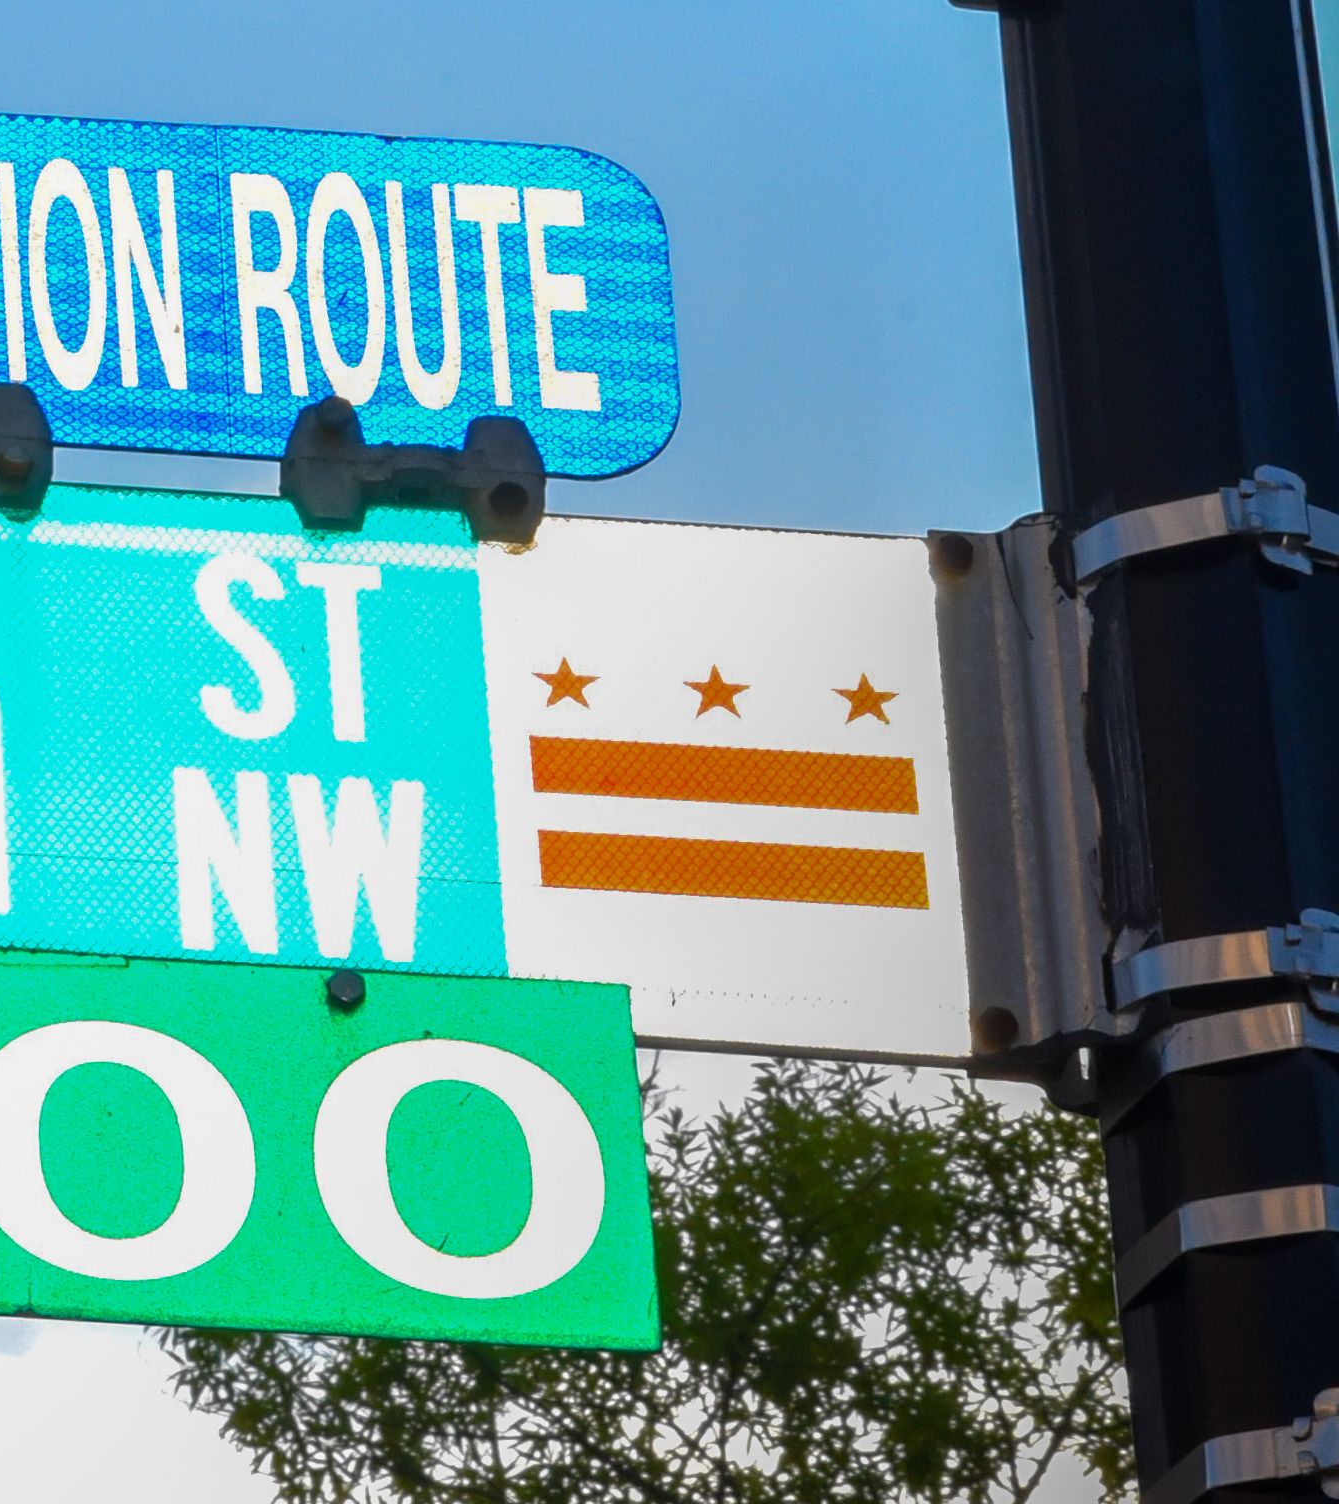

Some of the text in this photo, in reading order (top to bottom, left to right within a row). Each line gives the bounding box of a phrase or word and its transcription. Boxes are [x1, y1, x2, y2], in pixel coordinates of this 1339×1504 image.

[230, 173, 601, 411] ROUTE
[194, 552, 381, 742] ST
[173, 767, 424, 962] NW
